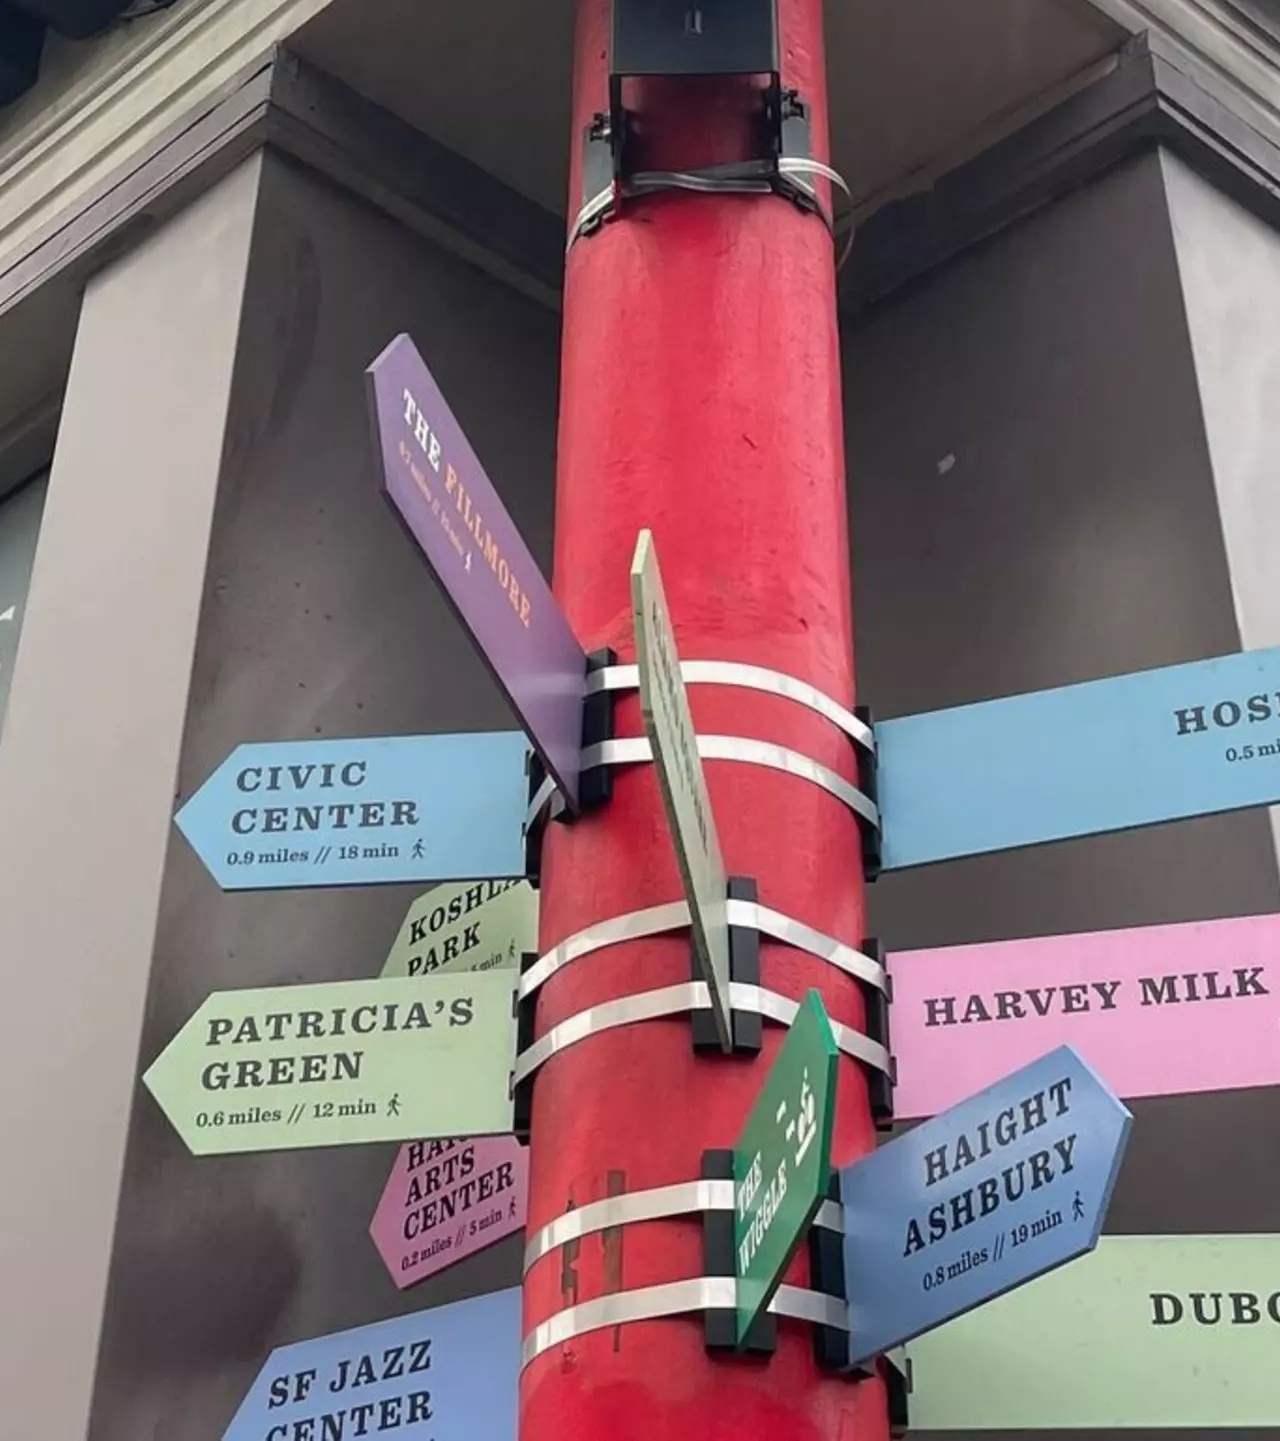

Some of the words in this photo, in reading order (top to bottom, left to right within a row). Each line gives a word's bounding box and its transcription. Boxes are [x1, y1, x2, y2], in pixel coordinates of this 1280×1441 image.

[403, 388, 441, 472] THE
[444, 463, 530, 628] FILLMORE
[236, 761, 367, 792] CIVIC
[1225, 745, 1254, 762] 0.5
[231, 801, 420, 834] CENTER
[227, 852, 255, 866] 0.9
[258, 848, 309, 864] miles
[339, 845, 359, 860] 18
[363, 843, 399, 858] min
[408, 880, 521, 946] KOSHL
[408, 921, 481, 977] PARK
[205, 998, 474, 1046] PATRICIA'S
[923, 980, 1121, 1027] HARVEY
[1138, 966, 1269, 1006] MILK
[201, 1052, 364, 1090] GREEN
[195, 1112, 224, 1128] 0.6
[227, 1108, 282, 1126] miles
[313, 1102, 334, 1119] 12
[338, 1098, 377, 1116] min
[923, 1077, 1072, 1188] HAIGHT
[403, 1162, 514, 1240] CENTER
[404, 1145, 475, 1207] ARTS
[737, 1151, 762, 1223] THE
[902, 1134, 1077, 1258] ASHBURY
[420, 1236, 452, 1261] miles
[469, 1220, 477, 1236] 5
[479, 1210, 502, 1231] min
[738, 1158, 787, 1276] WIGGLE
[923, 1267, 946, 1292] 0.8
[946, 1247, 989, 1283] miles
[1010, 1226, 1030, 1248] 19
[1031, 1208, 1063, 1238] min
[268, 1368, 317, 1410] SF
[329, 1339, 432, 1393] JAZZ
